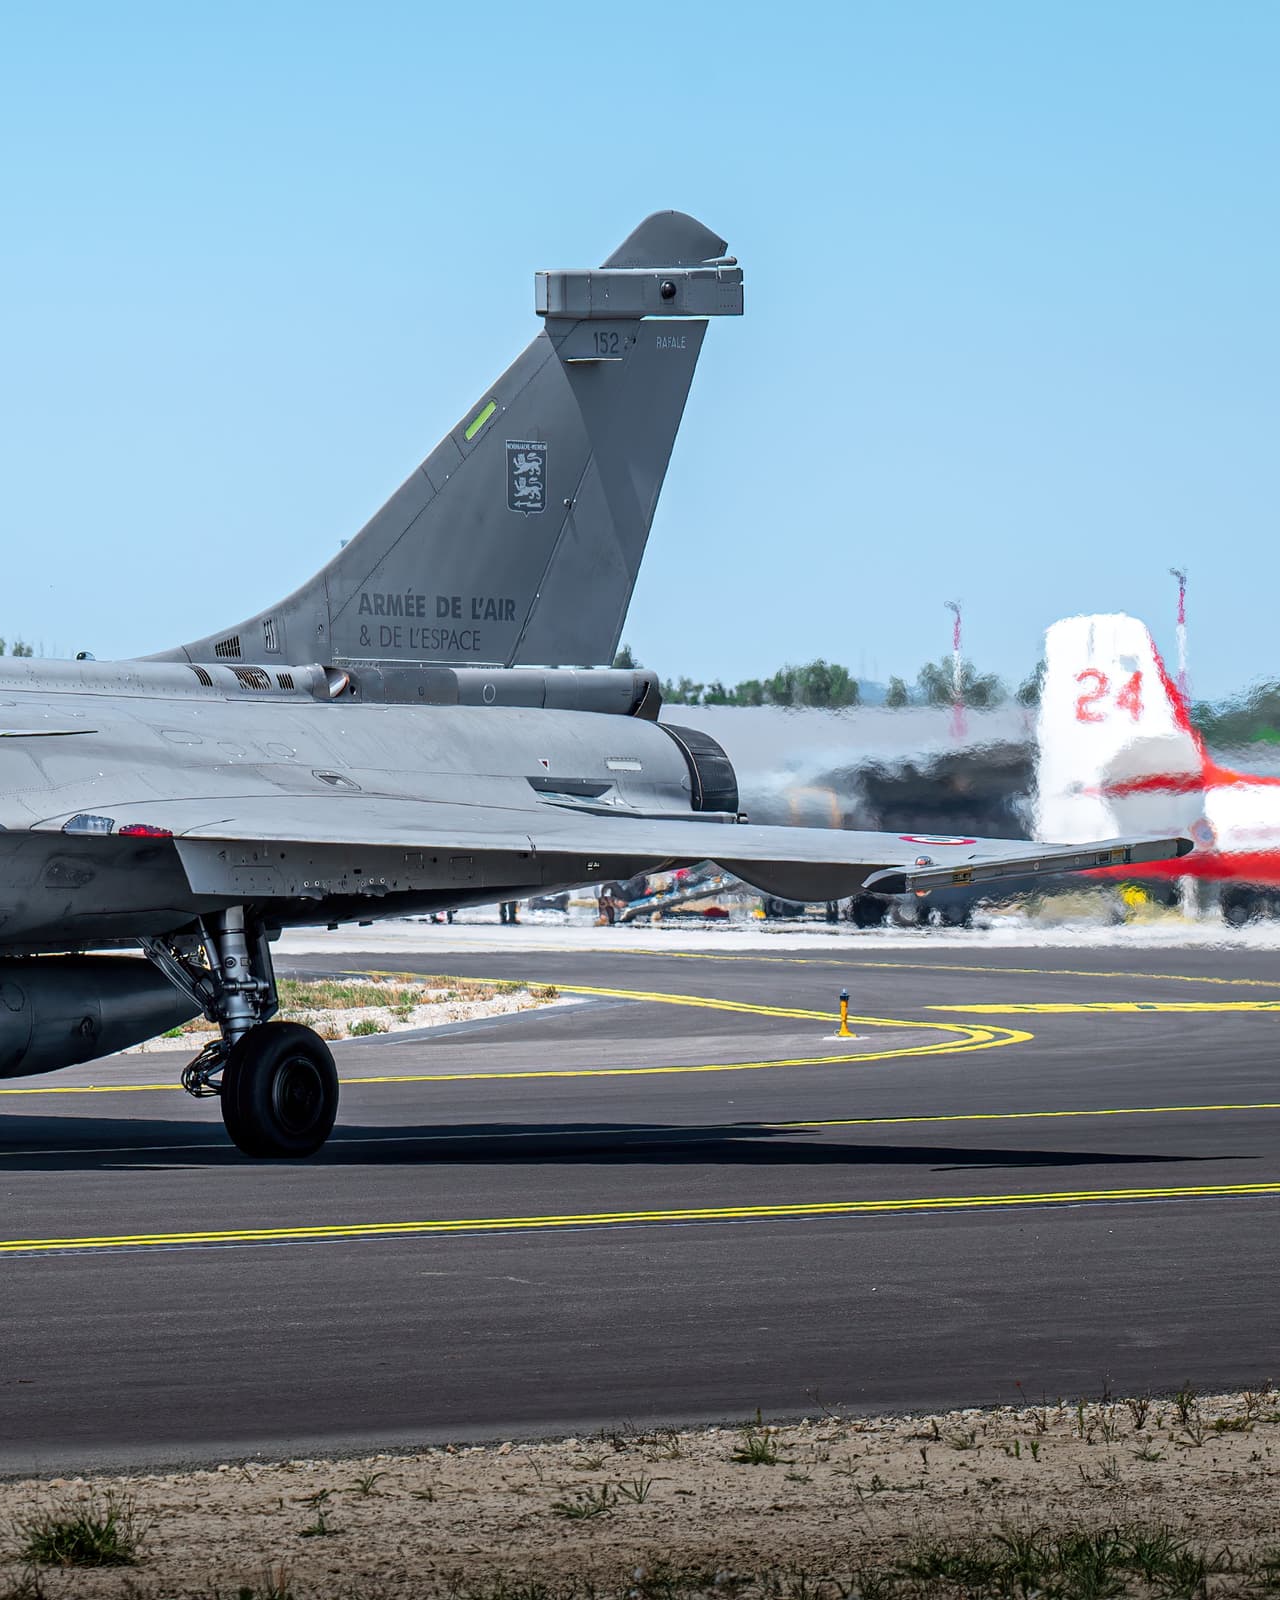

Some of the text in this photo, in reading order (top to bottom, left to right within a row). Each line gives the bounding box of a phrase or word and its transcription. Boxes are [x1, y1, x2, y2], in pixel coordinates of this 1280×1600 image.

[593, 332, 619, 354] 152
[656, 336, 687, 349] RAFALE
[358, 588, 516, 622] ARMÉE DE L'AIR
[359, 624, 481, 651] & DE L'ESPACE
[1073, 667, 1144, 723] 24
